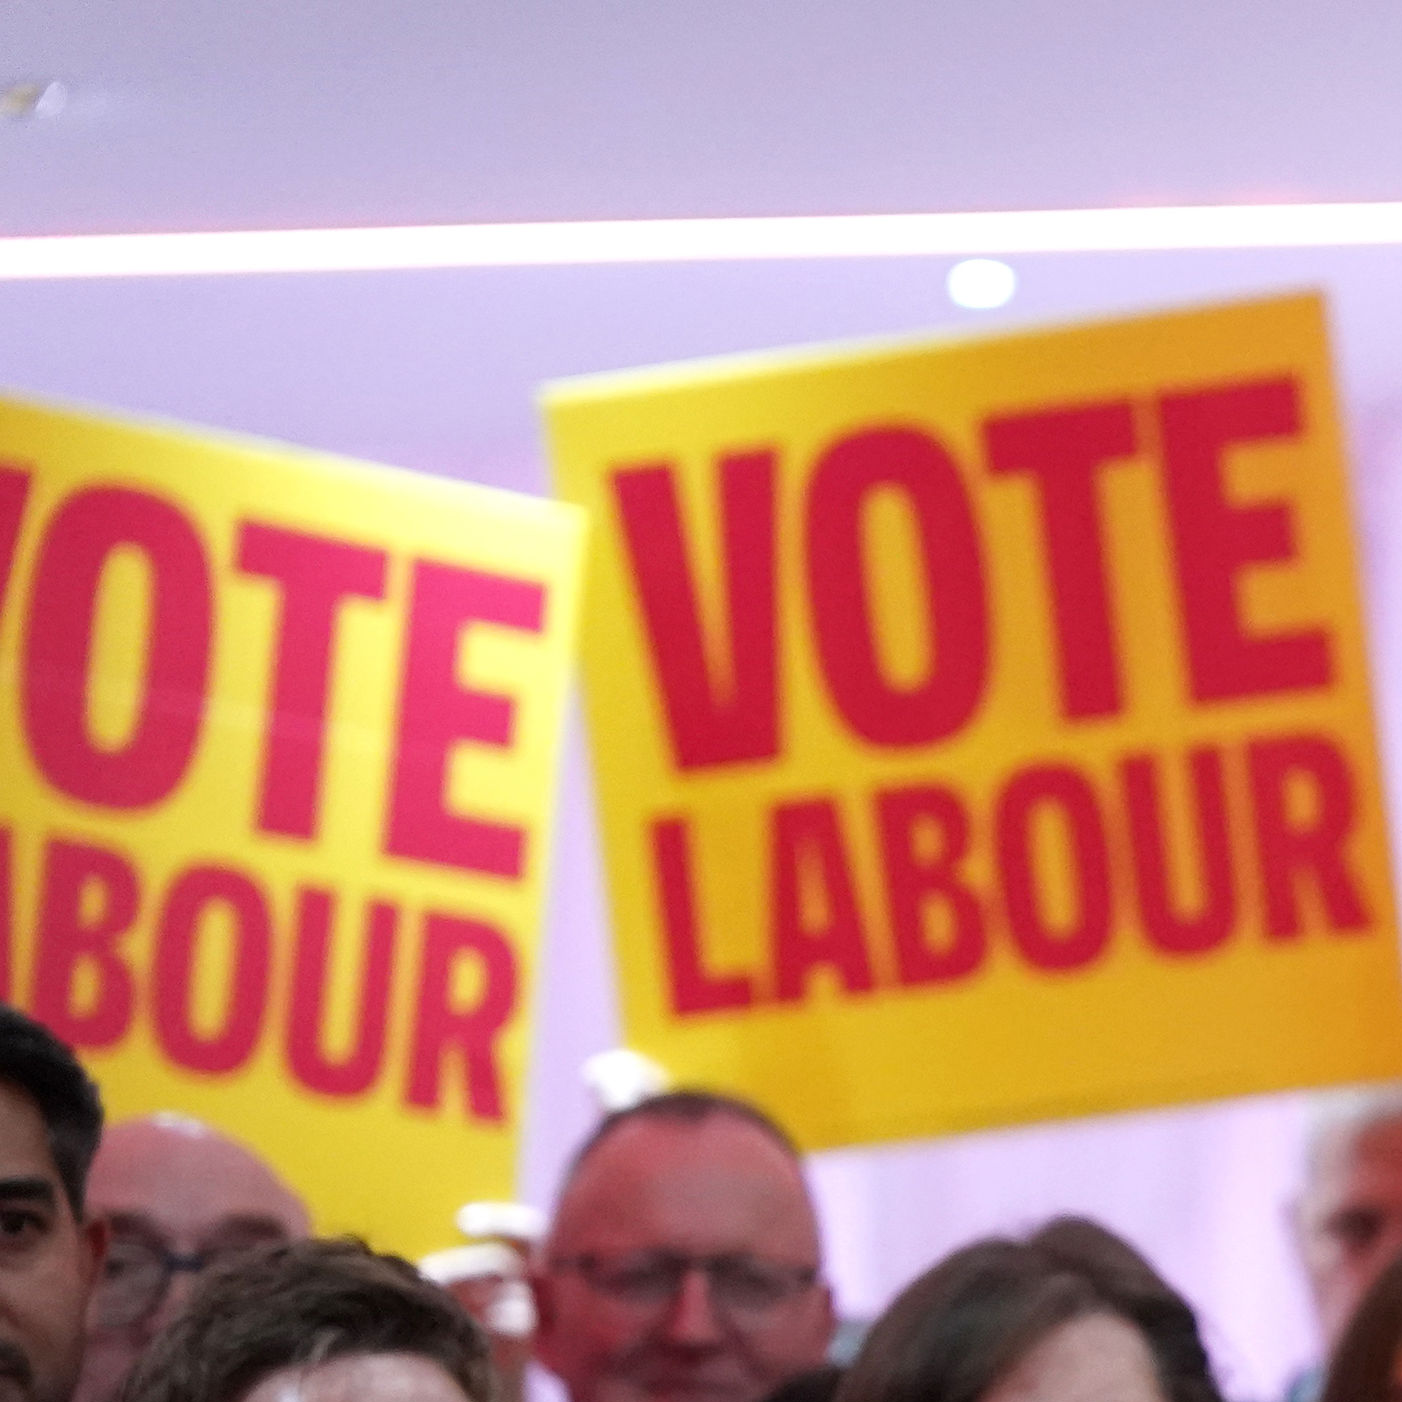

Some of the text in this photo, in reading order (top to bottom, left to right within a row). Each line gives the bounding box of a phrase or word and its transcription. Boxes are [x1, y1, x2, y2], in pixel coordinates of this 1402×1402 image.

[0, 458, 548, 884] OTE
[607, 370, 1341, 779] VOTE
[0, 820, 524, 1129] BOUR
[646, 725, 1378, 1023] LABOUR
